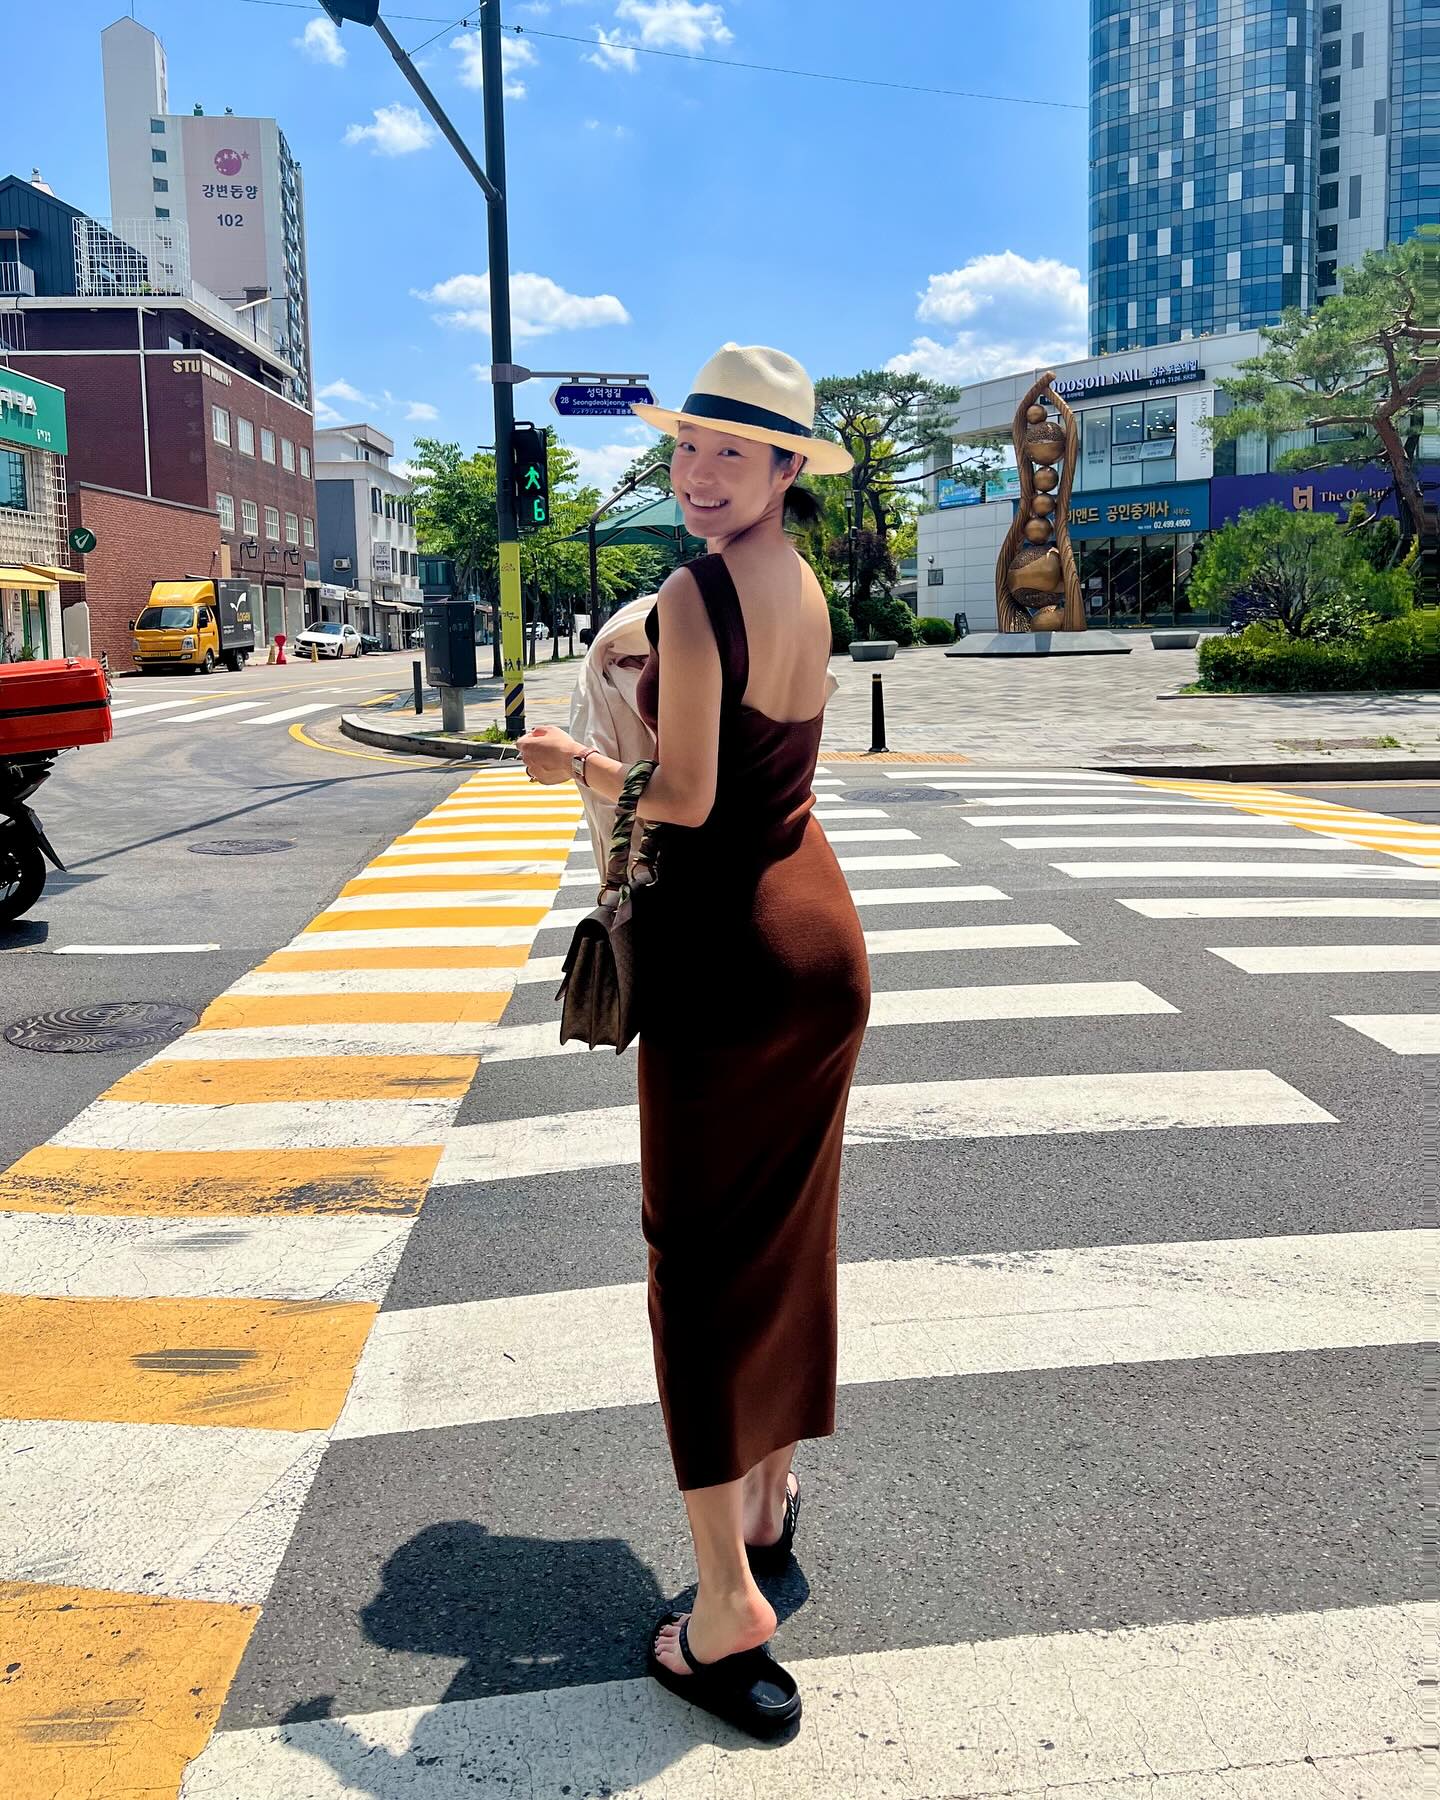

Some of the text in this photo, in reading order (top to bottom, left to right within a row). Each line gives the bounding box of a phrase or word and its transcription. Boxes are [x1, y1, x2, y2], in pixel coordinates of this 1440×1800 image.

[202, 184, 259, 200] 강변동양
[217, 214, 244, 227] 102
[1111, 368, 1142, 384] NAIL
[587, 388, 621, 398] 성덕정길
[560, 396, 570, 404] 28
[1320, 490, 1343, 502] The
[533, 499, 545, 521] 6
[1106, 500, 1169, 522] 공인중개사
[1153, 518, 1191, 529] 02.499.4900
